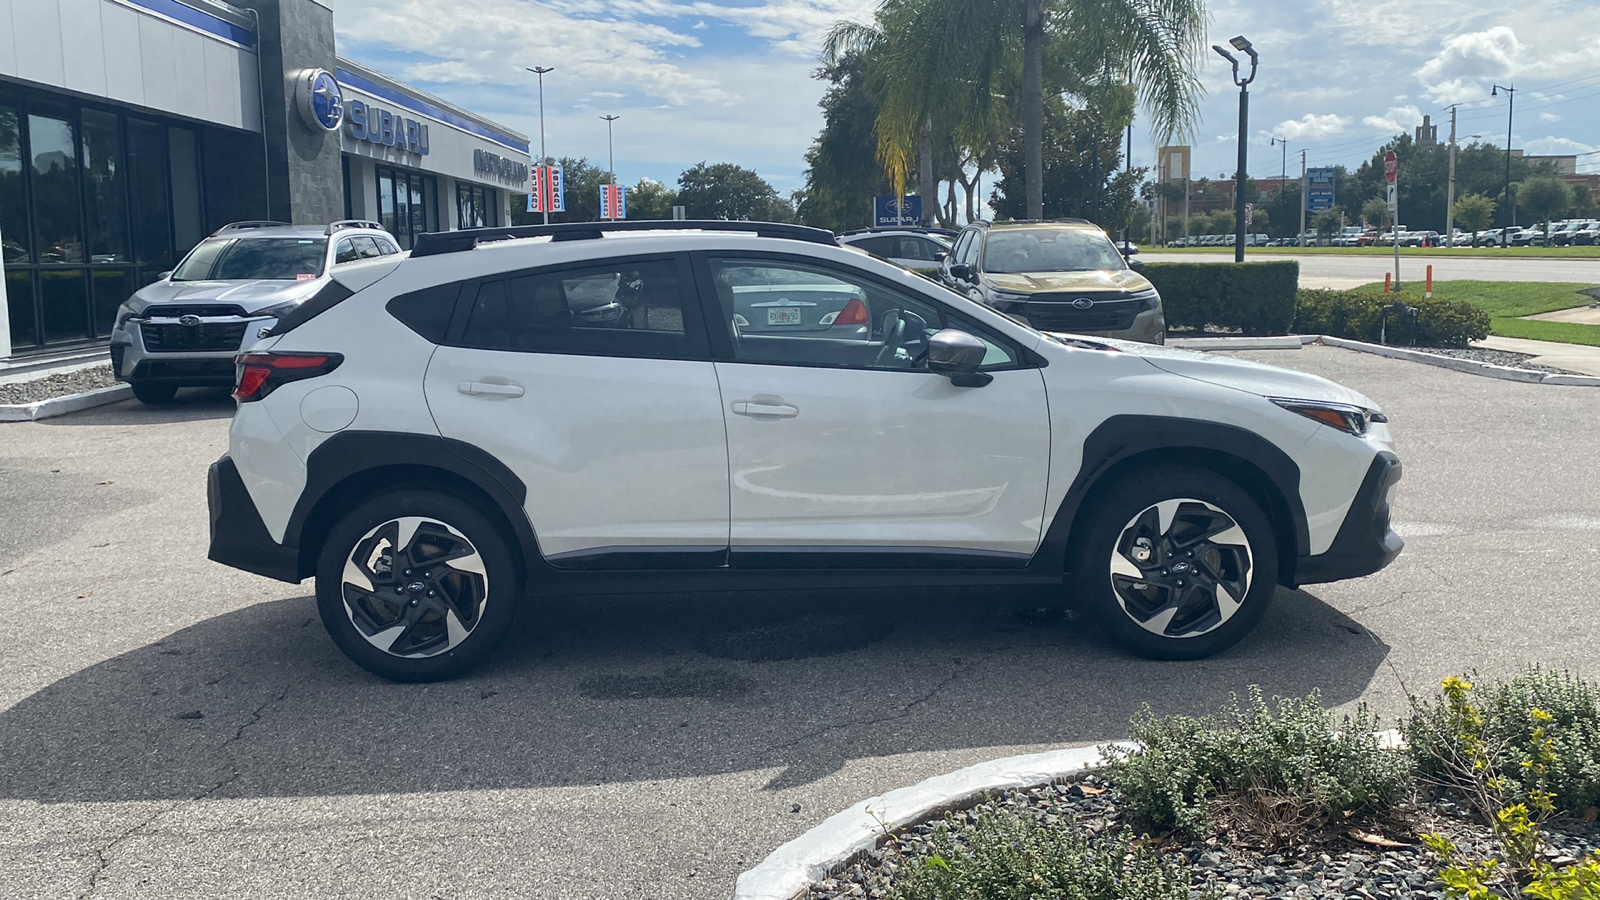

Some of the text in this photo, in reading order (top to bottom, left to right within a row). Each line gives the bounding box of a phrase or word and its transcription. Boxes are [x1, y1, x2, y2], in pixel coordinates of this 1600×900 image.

[346, 99, 430, 156] SUBARU
[1386, 160, 1396, 173] STOP
[552, 175, 561, 209] SUBARU
